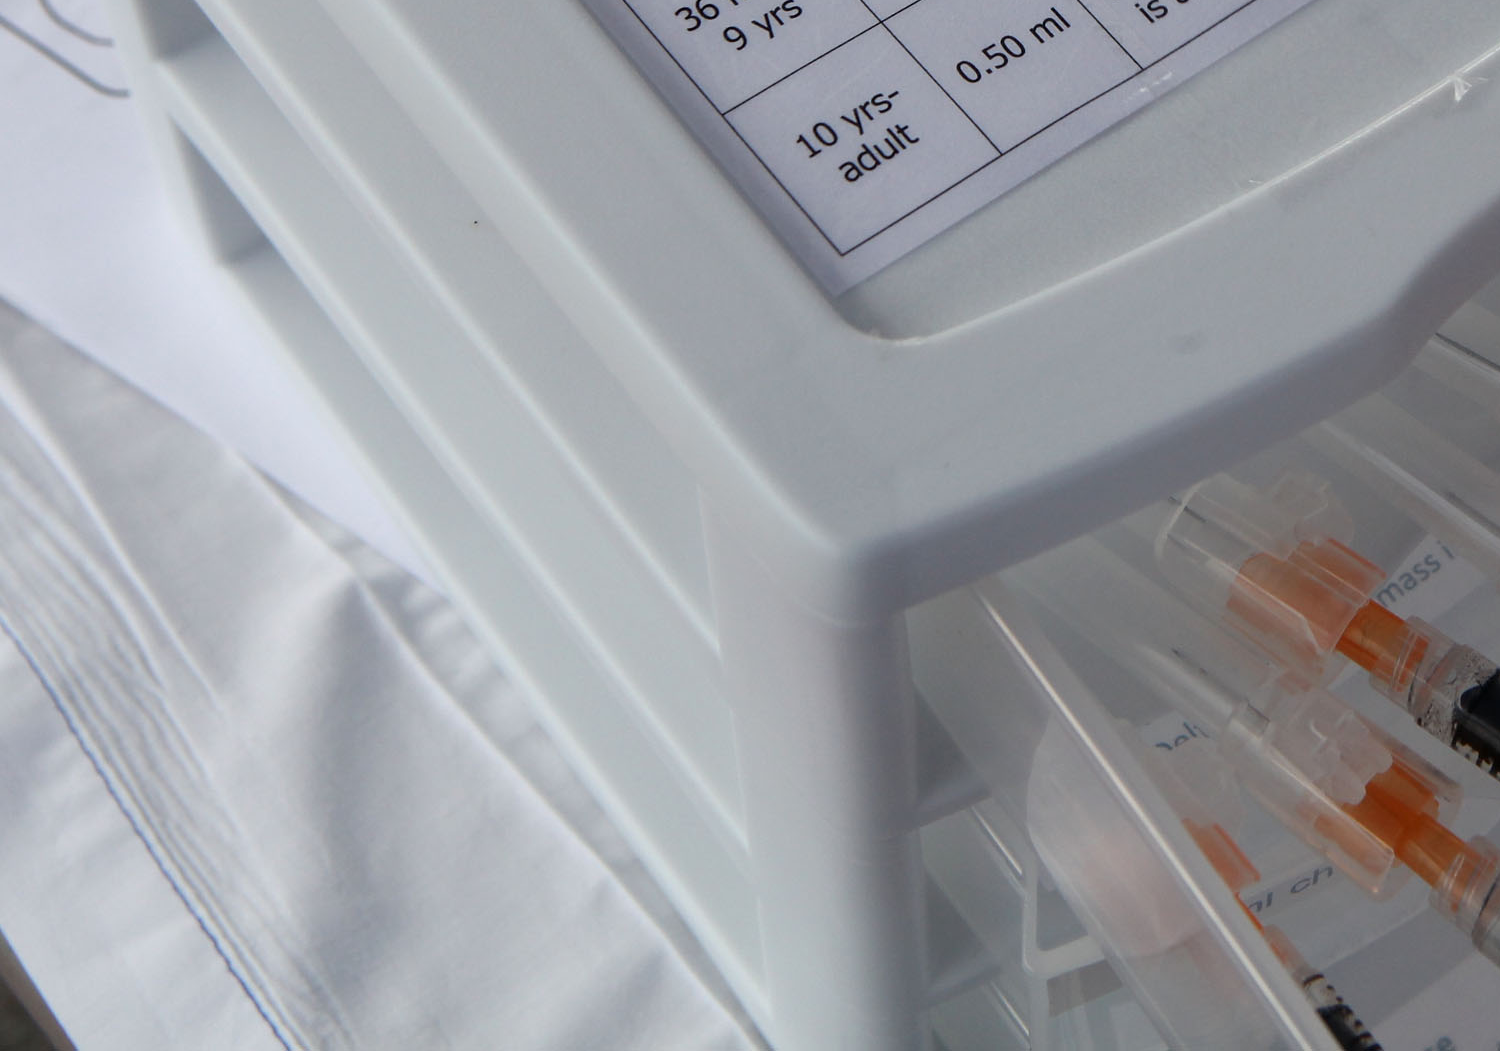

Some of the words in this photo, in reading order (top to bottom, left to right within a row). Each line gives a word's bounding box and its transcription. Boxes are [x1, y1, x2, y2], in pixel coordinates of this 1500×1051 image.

[722, 25, 748, 52] 9
[955, 34, 1027, 84] 0.50
[1028, 6, 1072, 45] ml
[795, 121, 839, 159] 10
[839, 90, 900, 136] yrs-
[837, 123, 921, 183] adult
